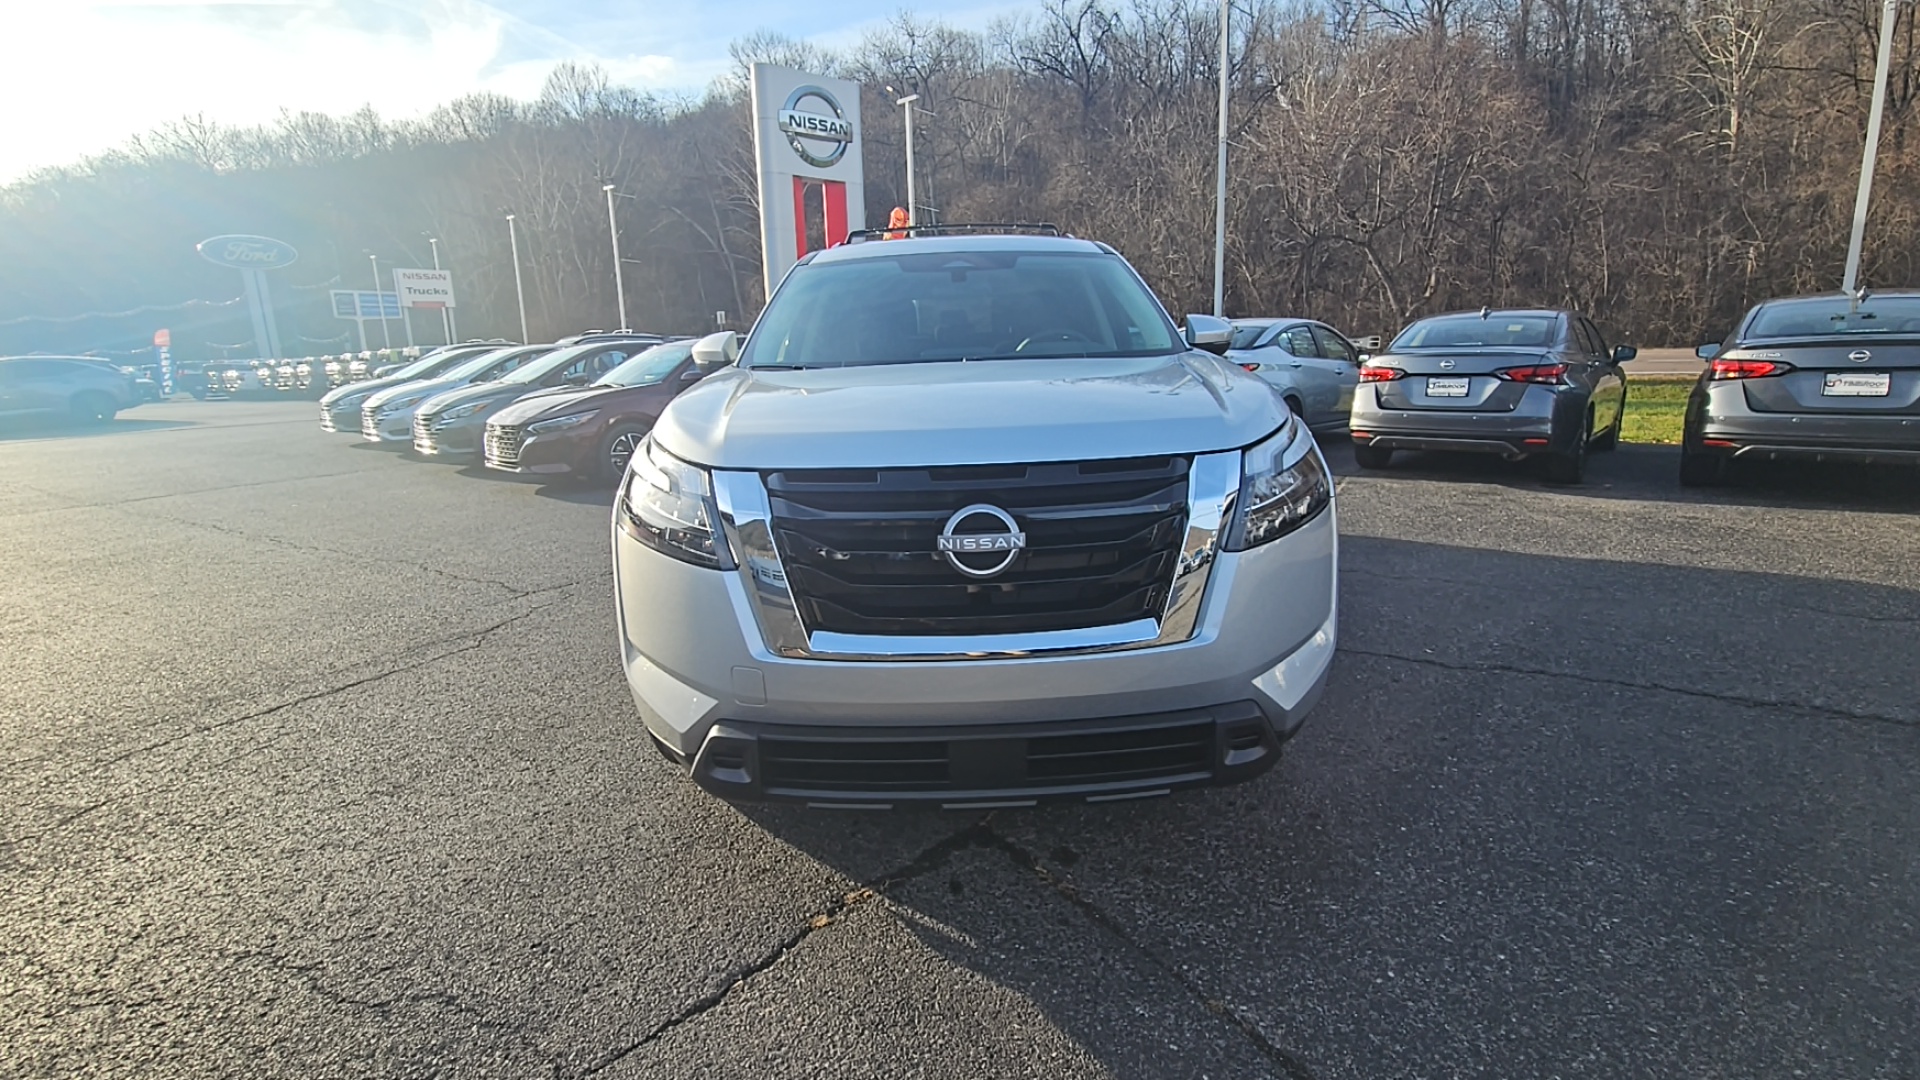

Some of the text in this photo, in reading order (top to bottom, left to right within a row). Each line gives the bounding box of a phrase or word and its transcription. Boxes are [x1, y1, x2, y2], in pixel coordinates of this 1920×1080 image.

[788, 114, 849, 136] NISSAN
[223, 241, 278, 262] Ford
[402, 272, 447, 281] NISSAN
[405, 286, 449, 296] Trucks
[939, 536, 1024, 550] NISSAN
